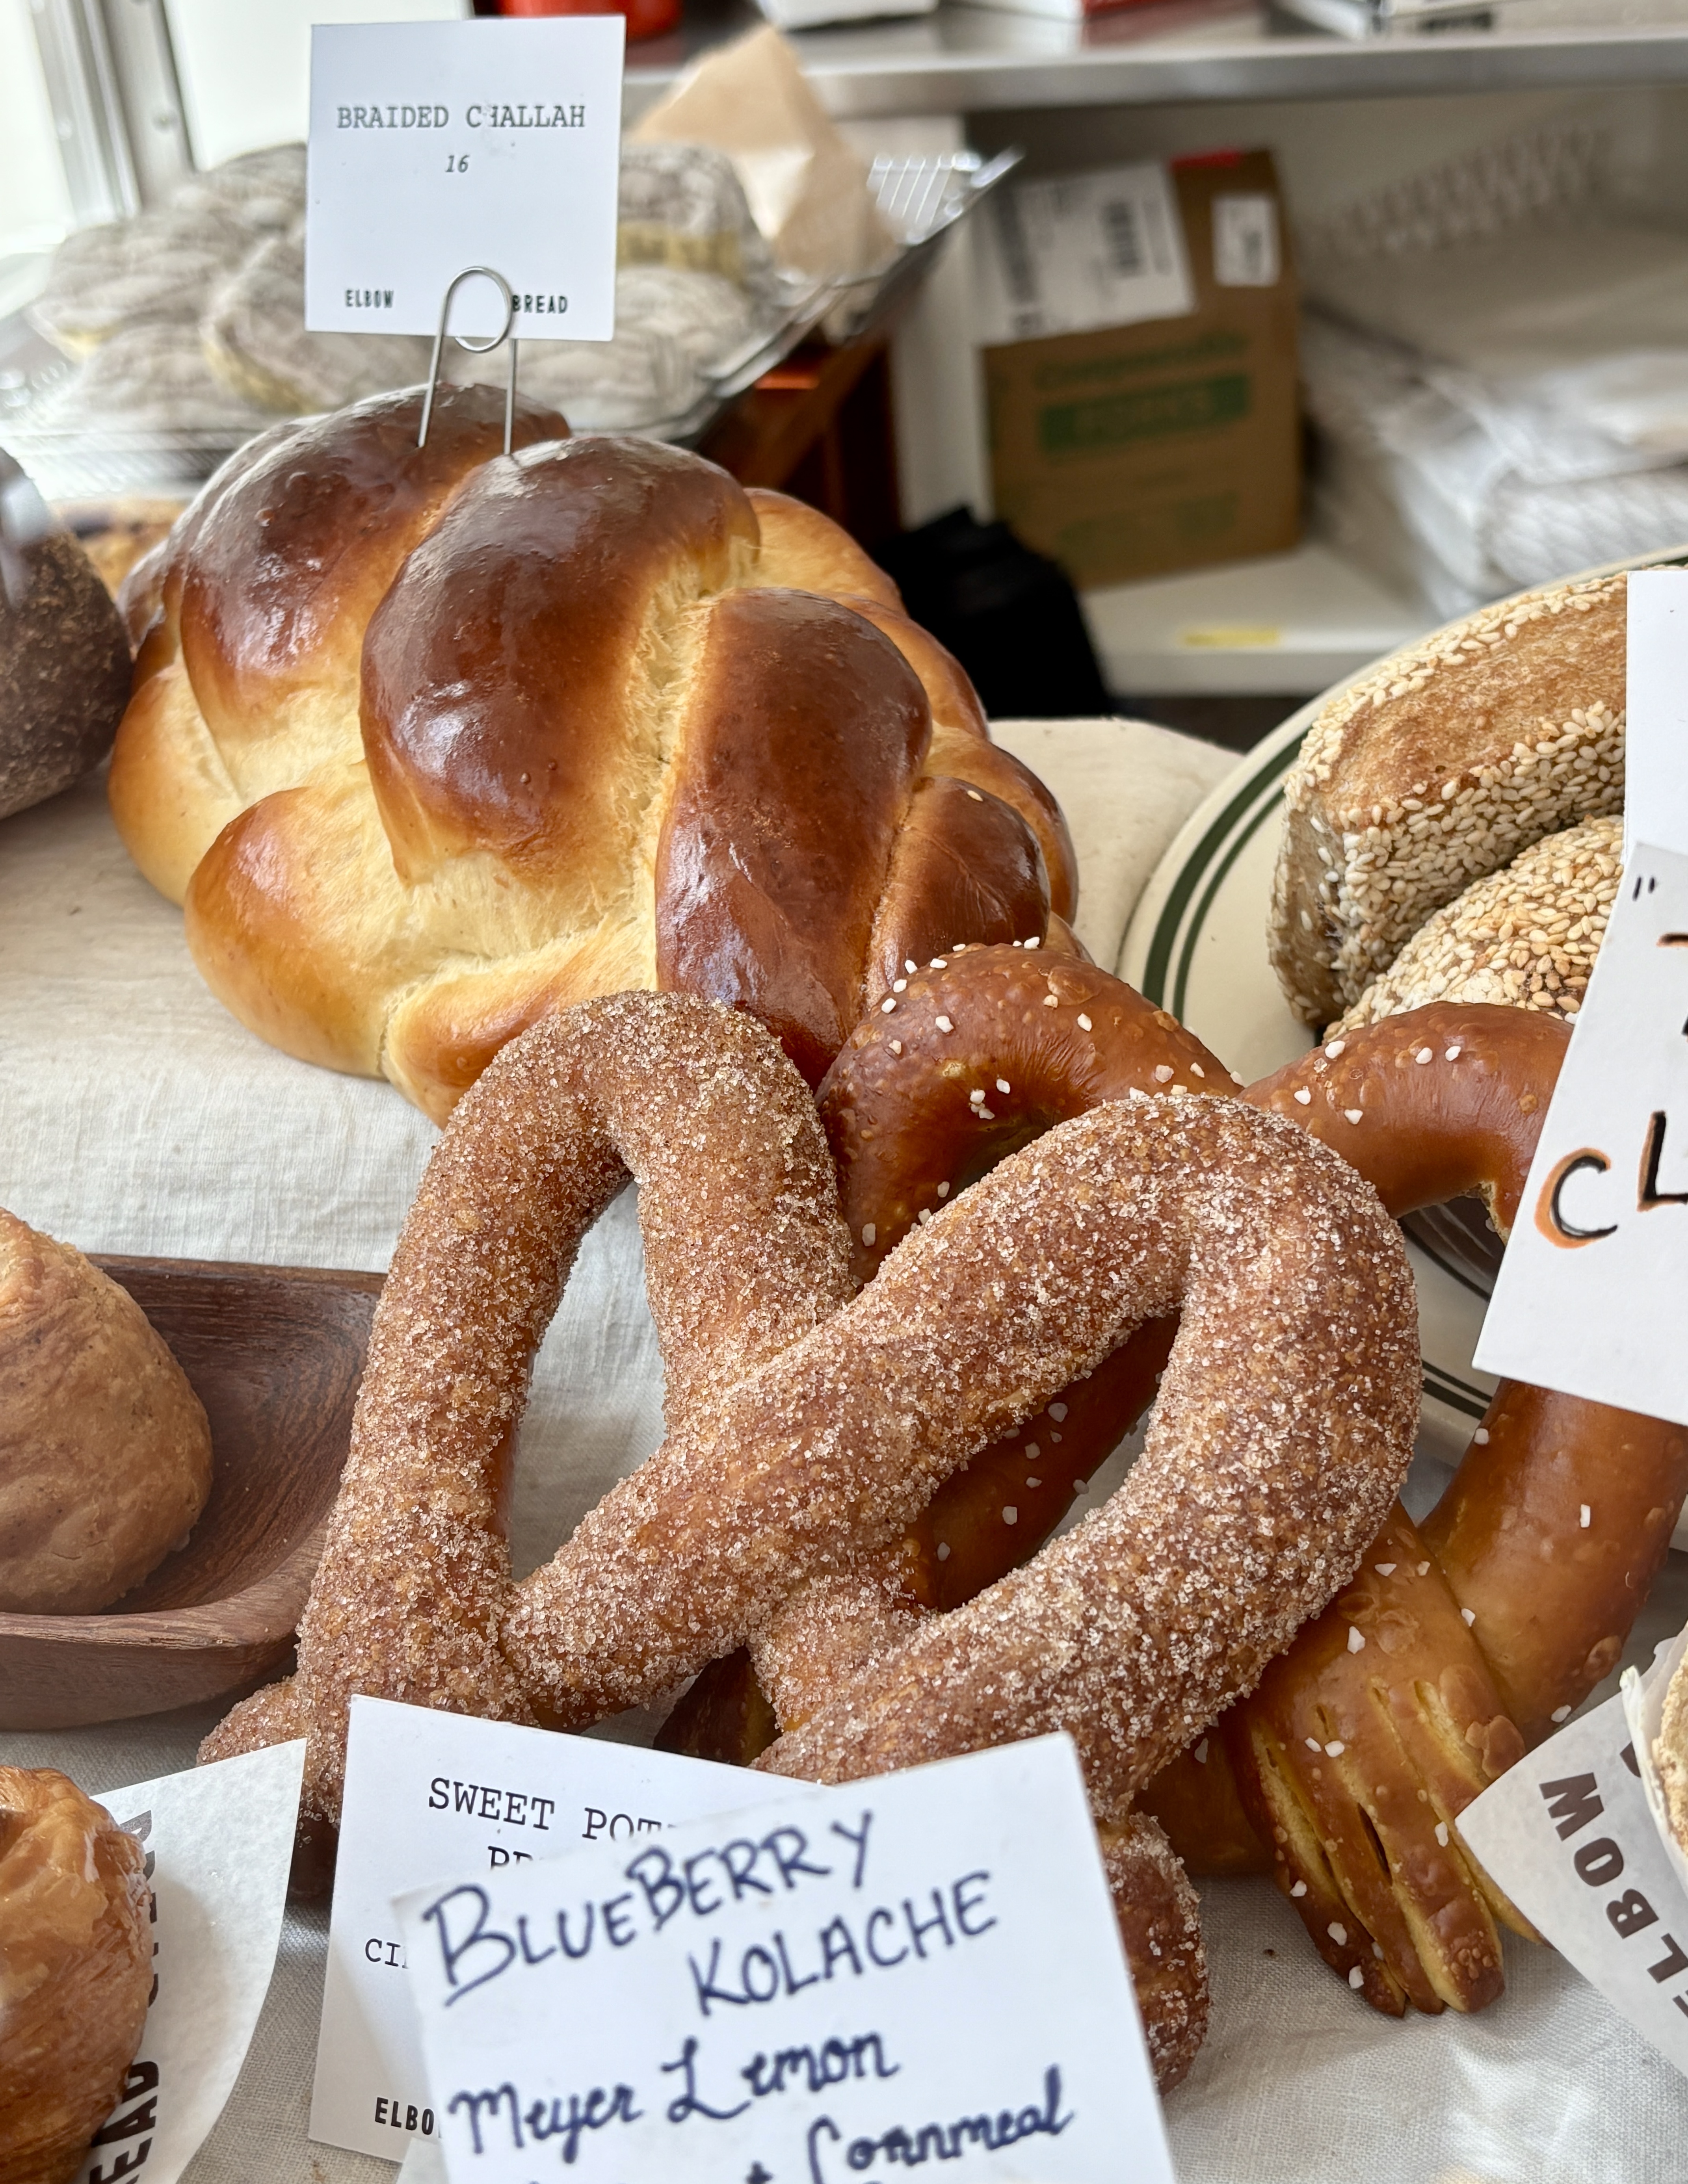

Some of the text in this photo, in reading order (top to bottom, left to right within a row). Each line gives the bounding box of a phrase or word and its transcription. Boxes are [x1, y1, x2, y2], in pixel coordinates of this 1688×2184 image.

[337, 106, 449, 128] BRAIDED
[445, 155, 470, 173] 16
[346, 289, 568, 314] ELBOW BREAD
[428, 1777, 555, 1830] SWEET
[1539, 1772, 1688, 2019] LBOW
[689, 1870, 1000, 2017] KOLACHE
[89, 2061, 159, 2184] EAD
[375, 2097, 441, 2138] ELBO
[447, 2031, 902, 2164] Meyer Lemon
